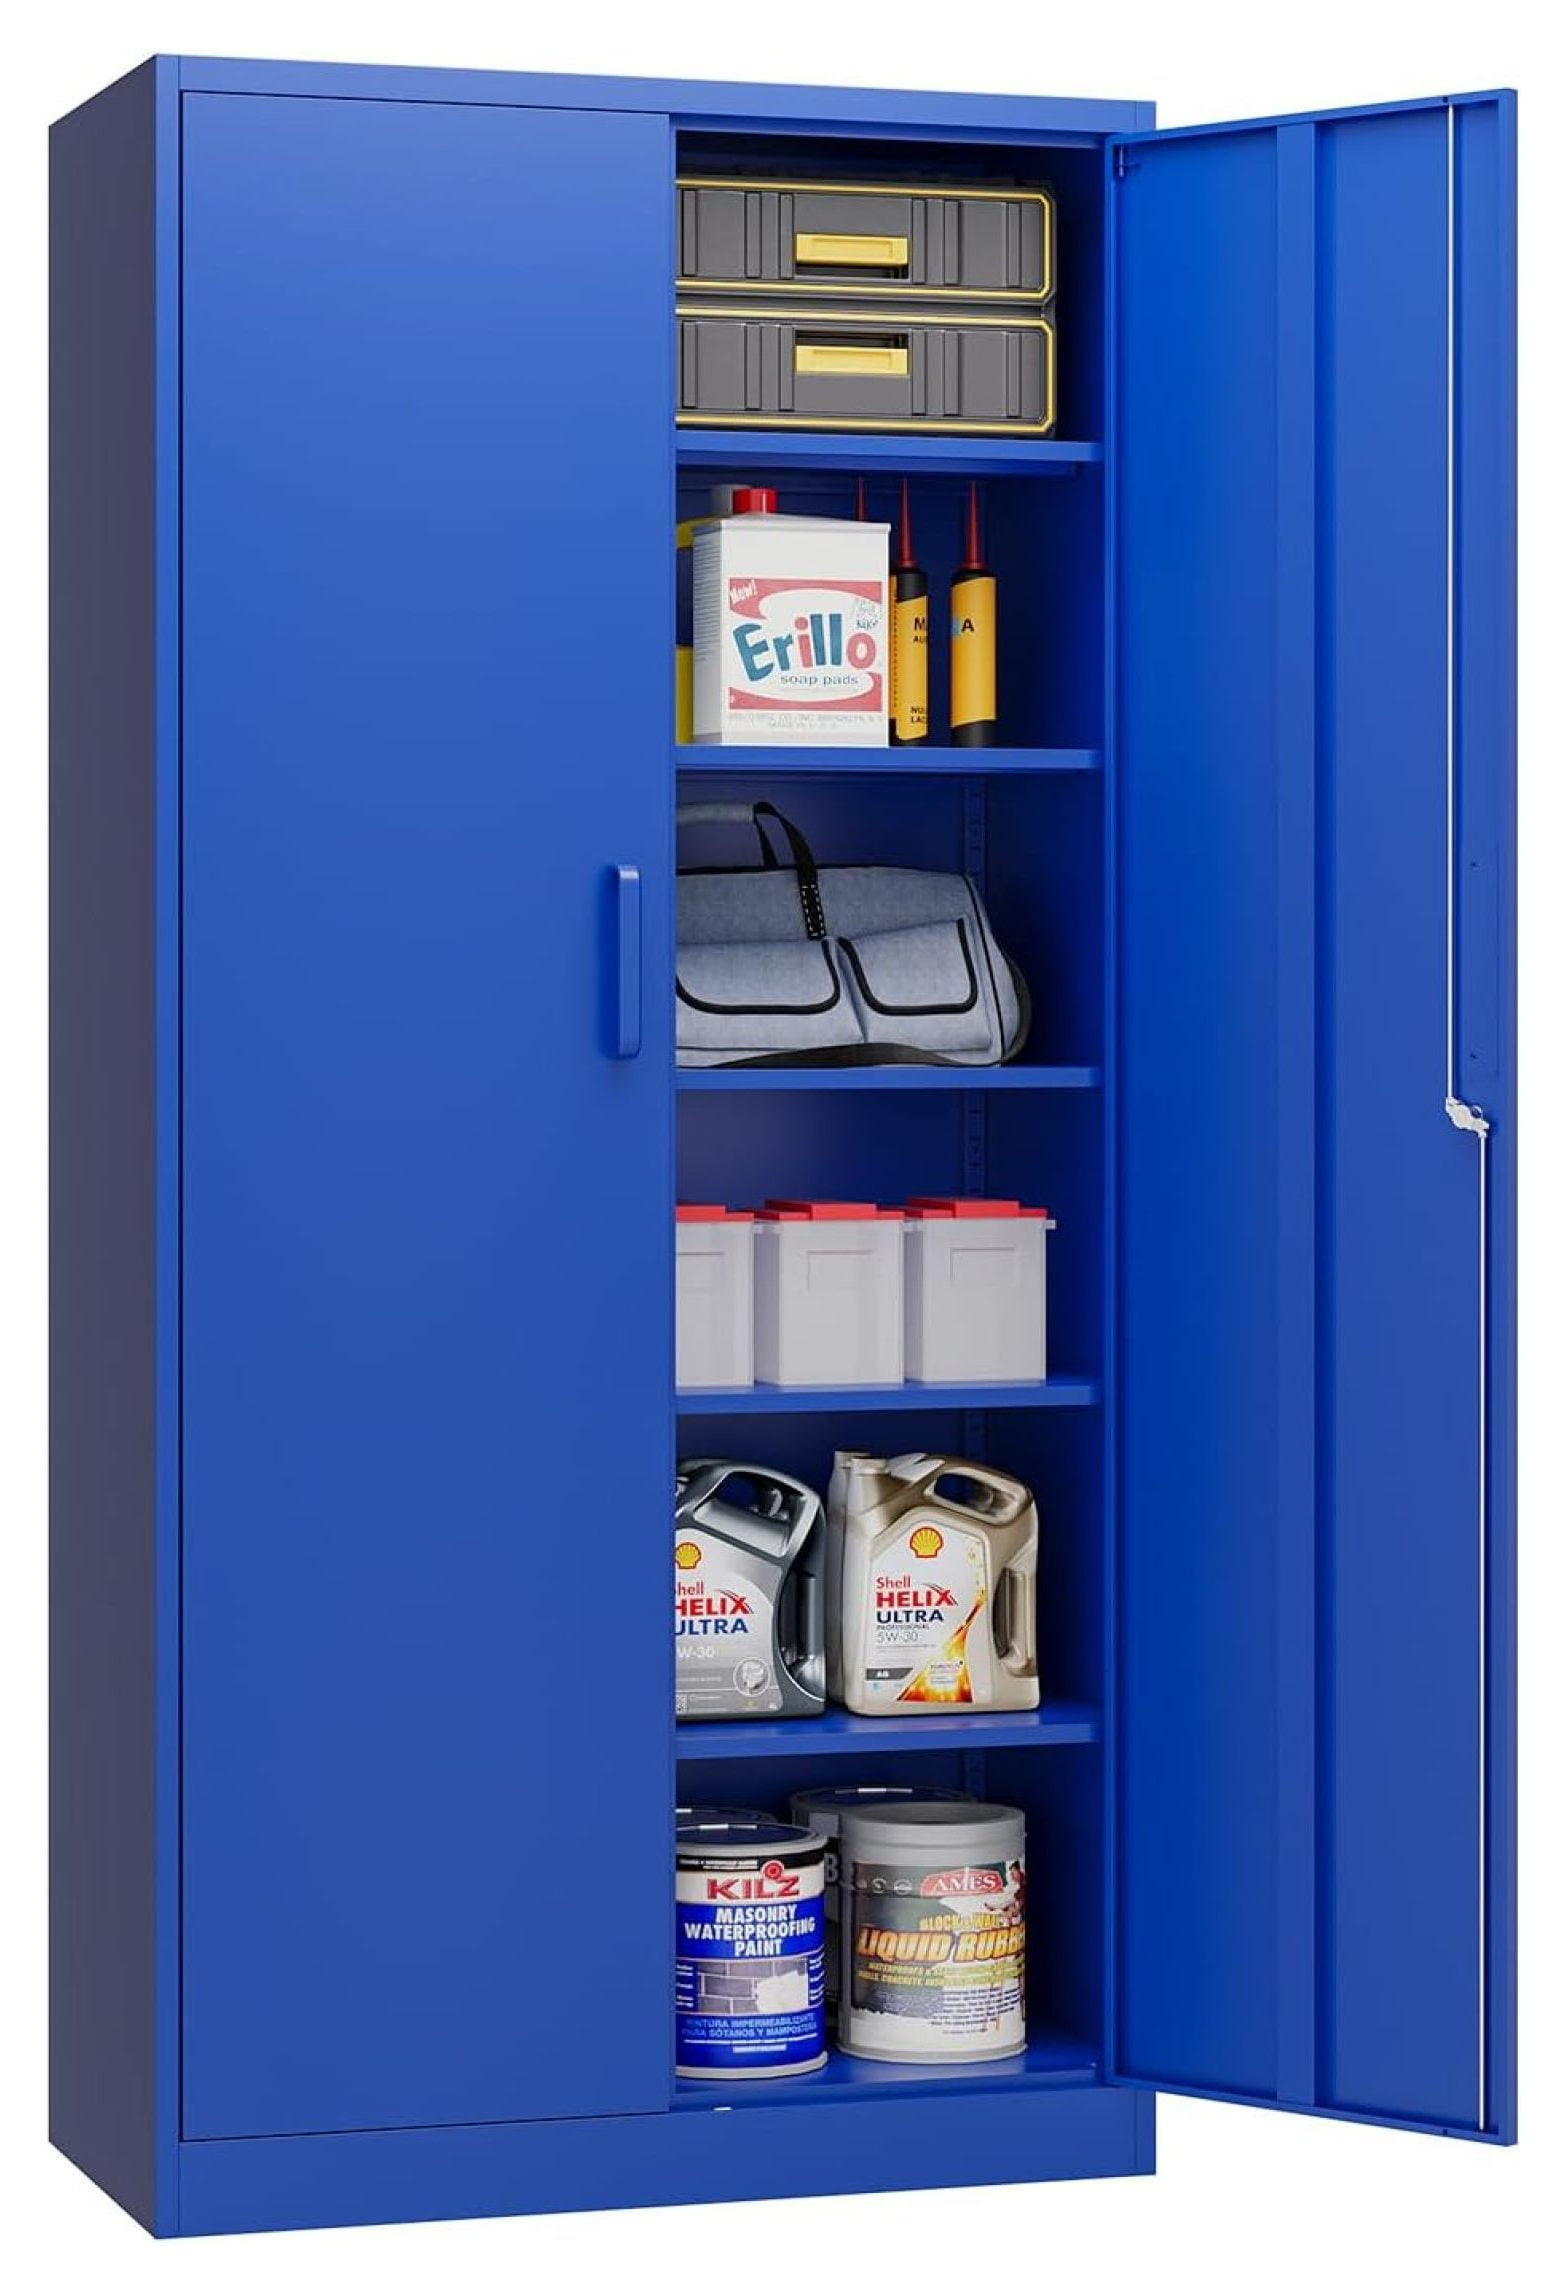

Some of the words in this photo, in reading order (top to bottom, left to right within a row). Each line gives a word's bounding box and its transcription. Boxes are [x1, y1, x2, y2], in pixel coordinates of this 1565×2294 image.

[729, 578, 758, 602] New!
[732, 613, 876, 681] Erillo
[780, 675, 818, 685] soap
[823, 673, 859, 685] pads
[675, 1581, 704, 1595] hell
[876, 1574, 911, 1589] Shell
[675, 1597, 751, 1617] HELIX
[876, 1589, 955, 1608] HELIX
[876, 1608, 944, 1624] ULTRA
[675, 1618, 749, 1636] ULTRA
[876, 1631, 919, 1642] 5W-30
[676, 1646, 716, 1658] W-30
[707, 1873, 800, 1900] KILZ
[933, 1874, 996, 1891] AMES
[715, 1903, 798, 1925] MASONRY
[684, 1916, 816, 1940] WATERPROOFING
[734, 1938, 783, 1957] PAINT
[858, 1928, 950, 1962] LIQUID
